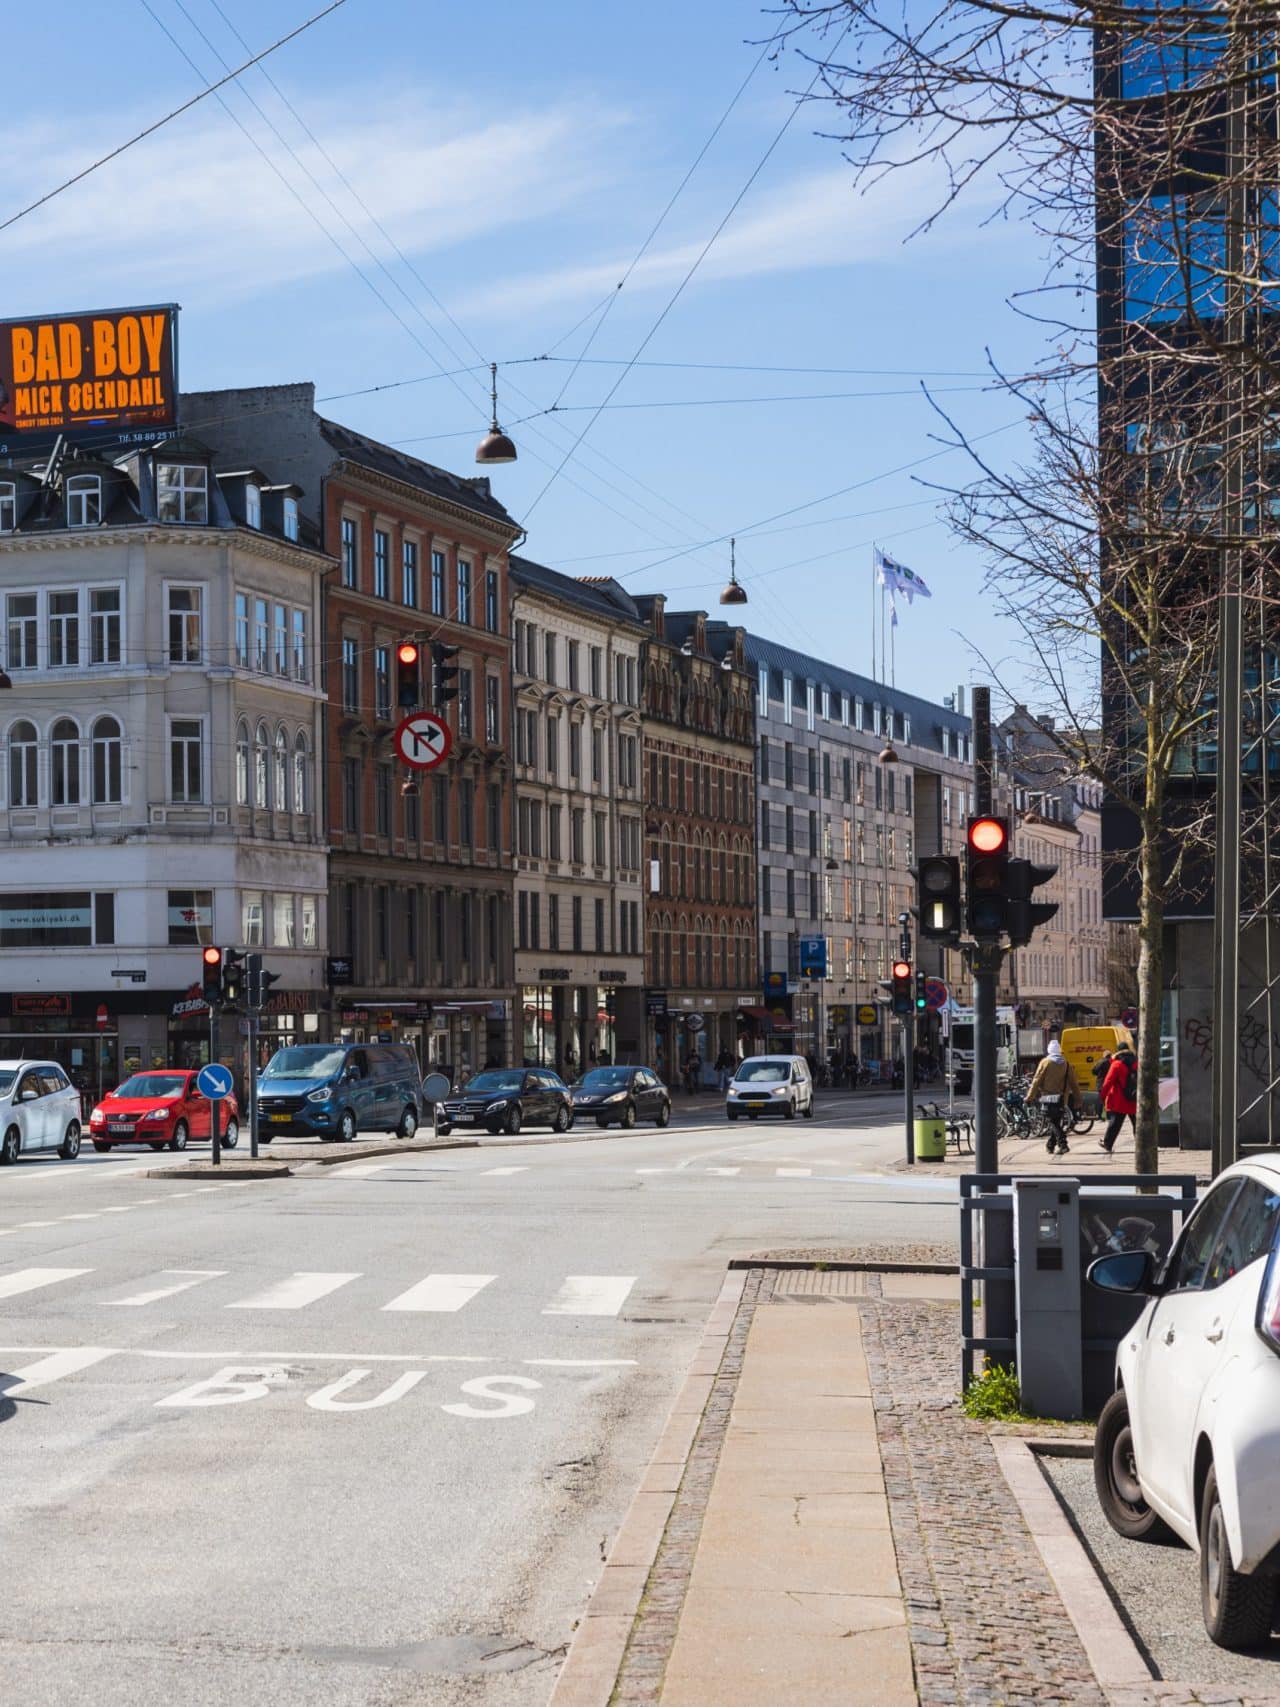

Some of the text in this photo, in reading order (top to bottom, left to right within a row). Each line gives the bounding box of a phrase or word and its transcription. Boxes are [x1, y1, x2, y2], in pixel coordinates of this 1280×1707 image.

[11, 314, 165, 384] BAD BOY
[15, 385, 64, 416] MICK
[9, 914, 80, 925] www.sukiyaki.dk
[808, 942, 820, 954] P
[154, 1363, 543, 1419] BUS
